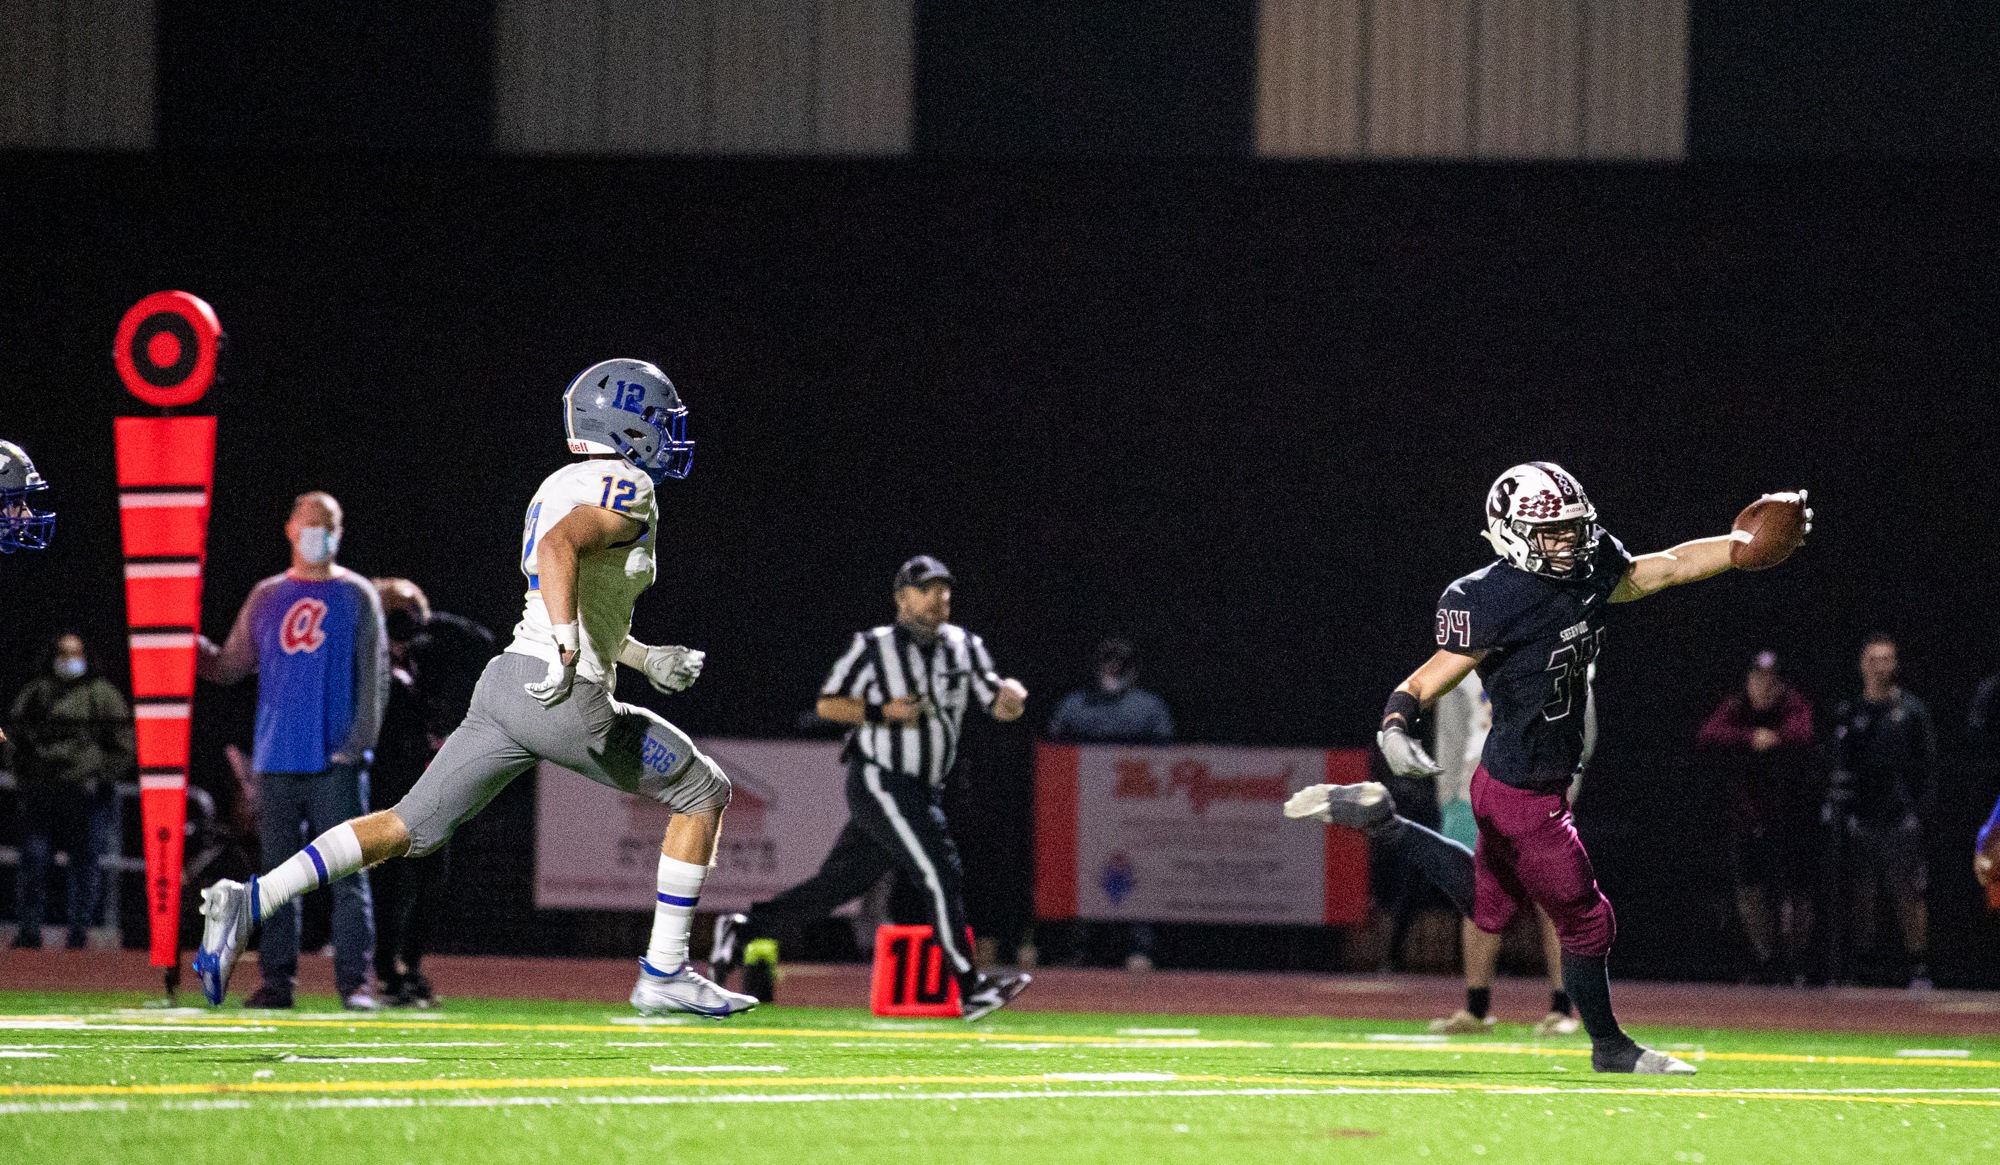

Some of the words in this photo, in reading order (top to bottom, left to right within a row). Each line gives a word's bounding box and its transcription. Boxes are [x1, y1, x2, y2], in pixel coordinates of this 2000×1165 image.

[612, 380, 646, 415] 12
[600, 474, 638, 517] 12
[1436, 608, 1470, 647] 34
[643, 732, 676, 773] ERS
[891, 937, 950, 1006] 10
